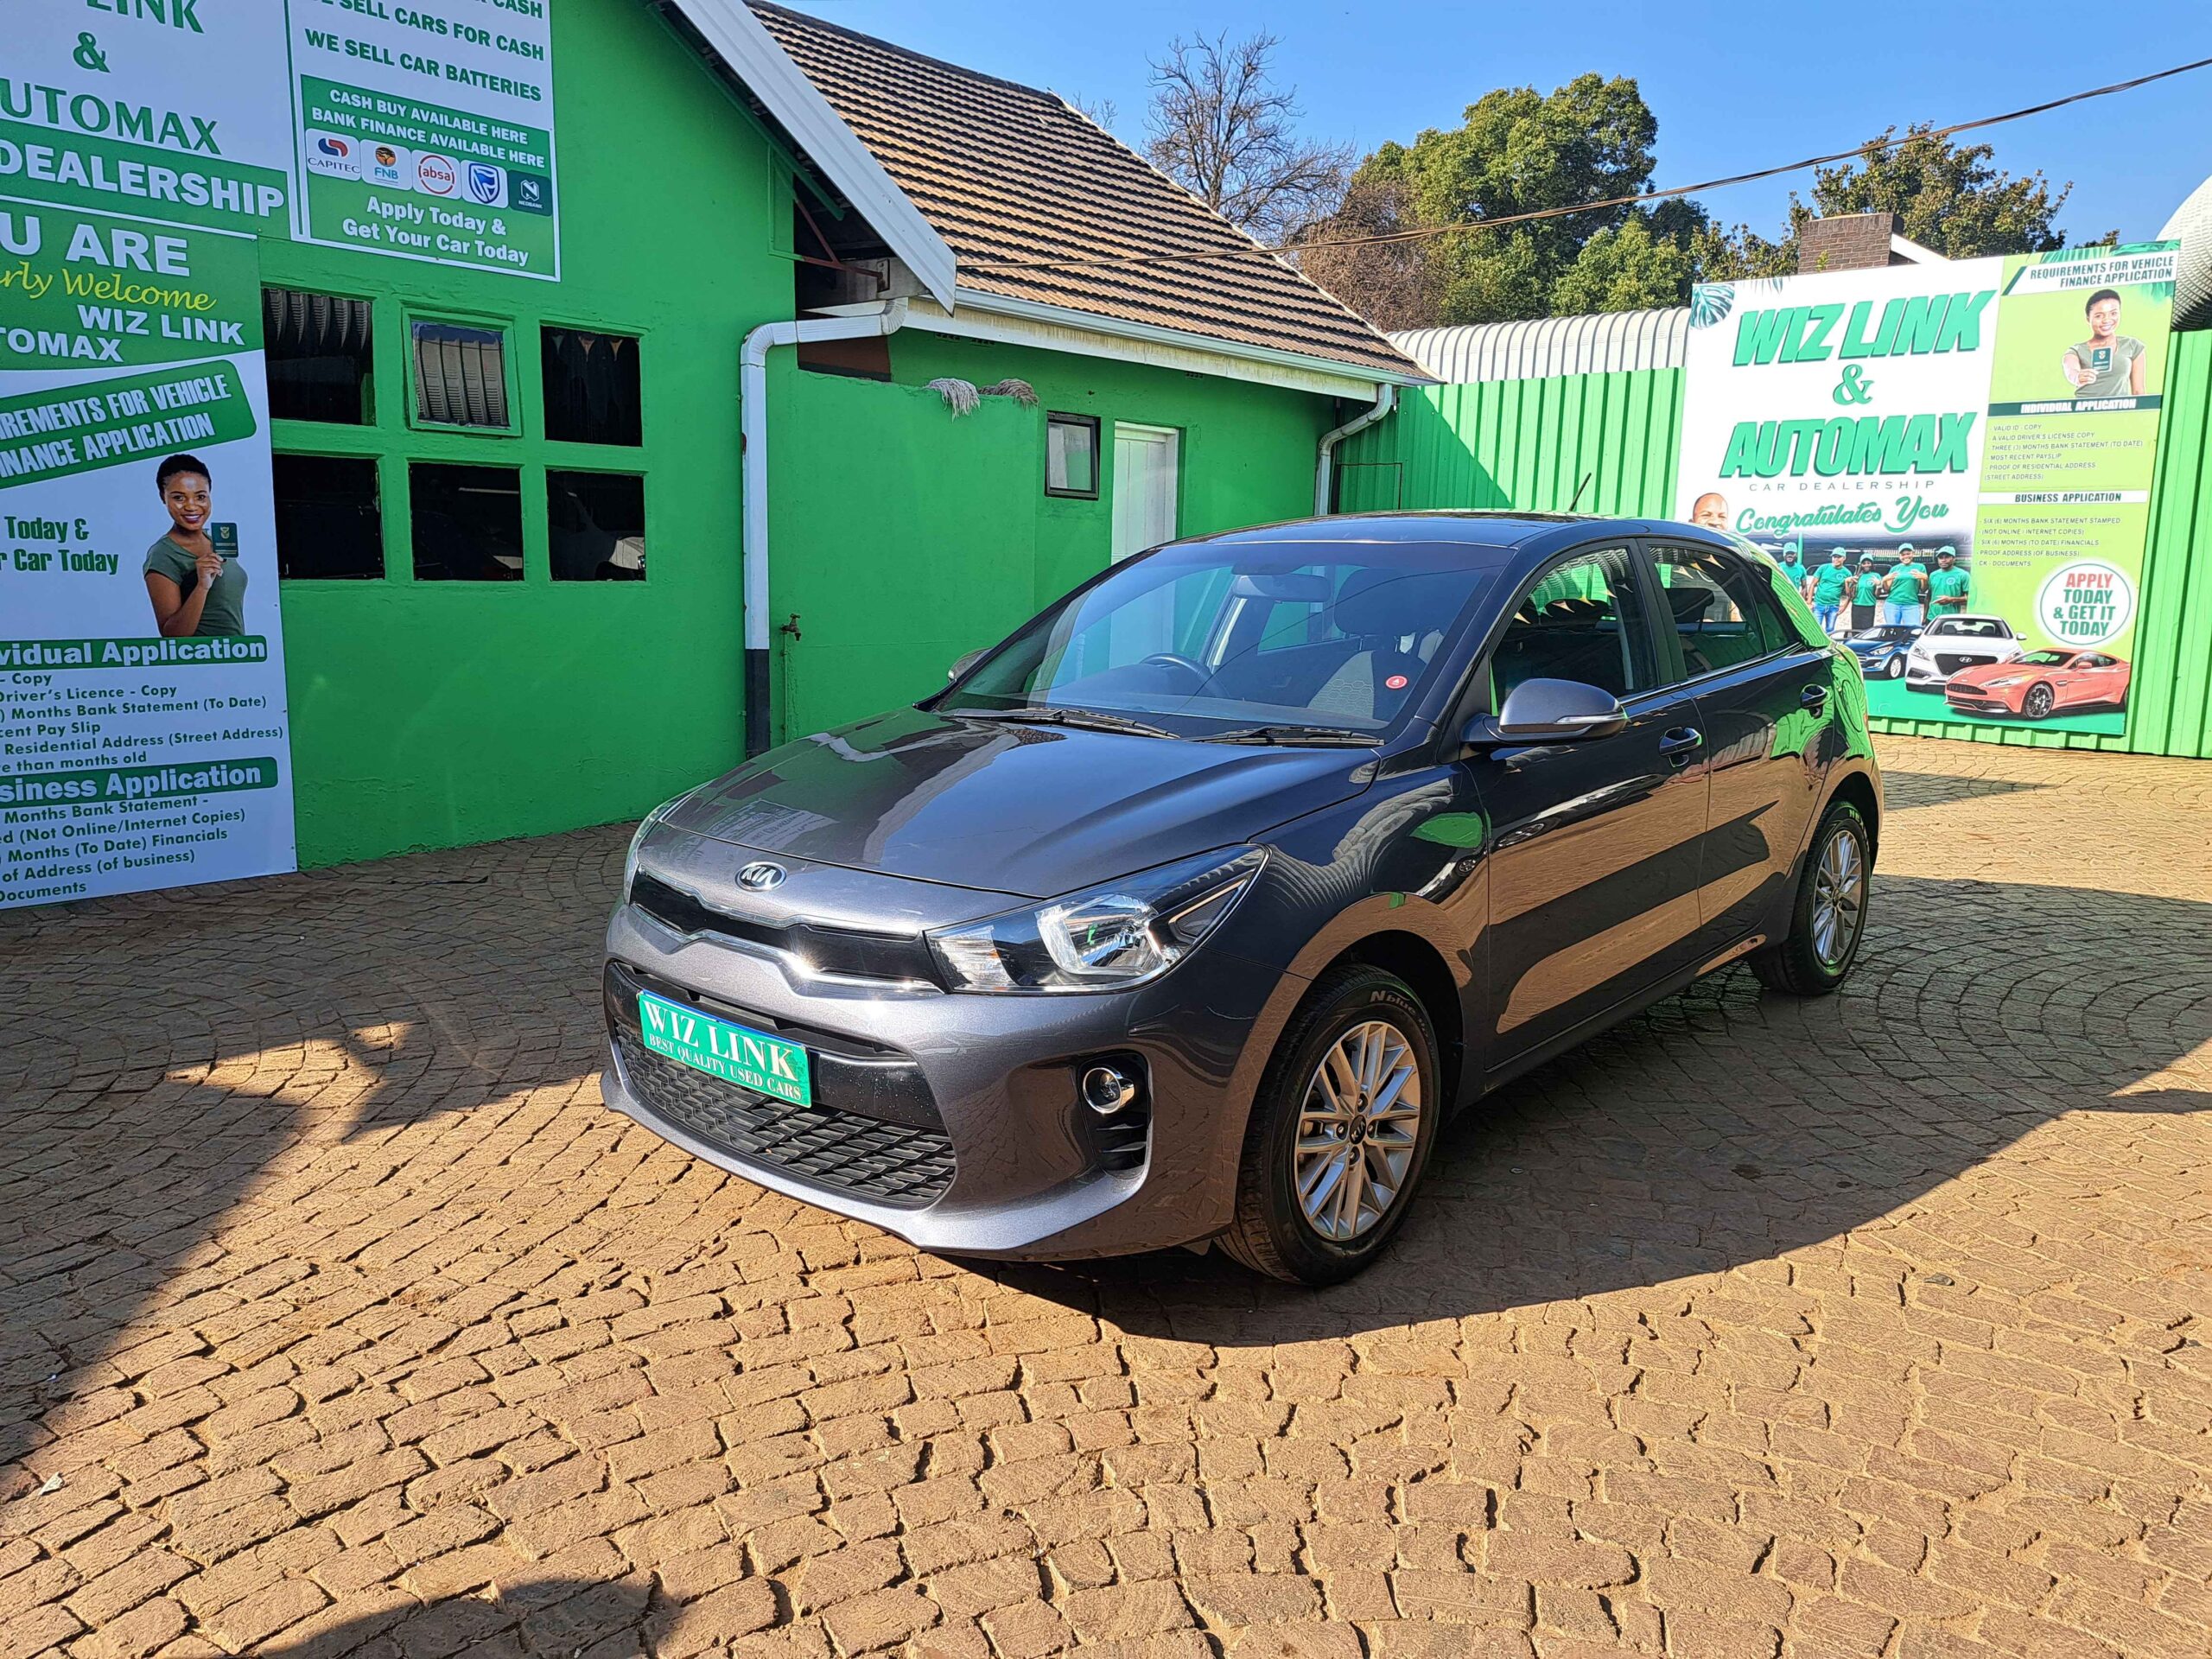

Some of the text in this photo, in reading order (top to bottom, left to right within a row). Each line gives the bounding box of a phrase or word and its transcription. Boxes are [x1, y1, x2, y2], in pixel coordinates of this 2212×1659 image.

[394, 7, 448, 35] CARS
[453, 22, 492, 48] FOR
[496, 35, 544, 61] CASH
[73, 32, 111, 73] &
[304, 28, 543, 103] WE SELL CAR BATTERIES
[329, 89, 529, 145] CASH BUY AVAILABLE HERE
[311, 106, 545, 169] BANK FINANCE AVAILABLE HERE
[307, 156, 361, 175] CAPITEC
[374, 167, 399, 180] FNB
[422, 166, 451, 182] absa
[366, 195, 507, 236] Apply Today &
[65, 223, 191, 277] ARE
[342, 218, 530, 267] Get Your Car Today
[2030, 255, 2175, 280] REQUIREMENTS FOR VEHICLE
[2059, 267, 2173, 289] FINANCE APPLICATION
[61, 268, 217, 312] Welcome
[76, 303, 245, 346] WIZ LINK
[1732, 289, 1998, 367] WIZ LINK
[105, 388, 151, 420] FOR
[149, 372, 232, 411] VEHICLE
[1832, 363, 1875, 405] &
[2020, 397, 2138, 415] INDIVIDUAL APPLICATION
[83, 411, 216, 462] APPLICATION
[1718, 411, 1978, 479] AUTOMAX
[1749, 480, 1936, 492] CAR DEALERSHIP
[2014, 492, 2122, 503] BUSINESS APPLICATION
[4, 516, 90, 543] Today &
[1735, 495, 1949, 538] Congratulates You
[13, 549, 119, 575] Car Today
[2065, 572, 2114, 589] APPLY
[2063, 588, 2114, 605] TODAY
[2053, 604, 2116, 621] & GET IT
[2059, 620, 2110, 637] TODAY
[101, 637, 266, 667] Application
[12, 672, 53, 687] Copy
[67, 687, 125, 700] Licence
[141, 684, 178, 698] Copy
[12, 695, 267, 721] Months Bank Statement (To Date)
[4, 726, 283, 755] Residential Address (Street Address)
[37, 723, 66, 738] Pay
[71, 721, 101, 735] Slip
[16, 750, 147, 772] than months old
[105, 764, 261, 799] Application
[4, 795, 198, 824] Months Bank Statement
[20, 808, 246, 845] (Not Online/Internet Copies)
[8, 827, 228, 862] Months (To Date) Financials
[2, 849, 195, 882] of Address (of business)
[741, 865, 778, 887] KIA
[642, 999, 799, 1083] WIZ LINK
[649, 1034, 803, 1101] BEST QUALITY USED CARS
